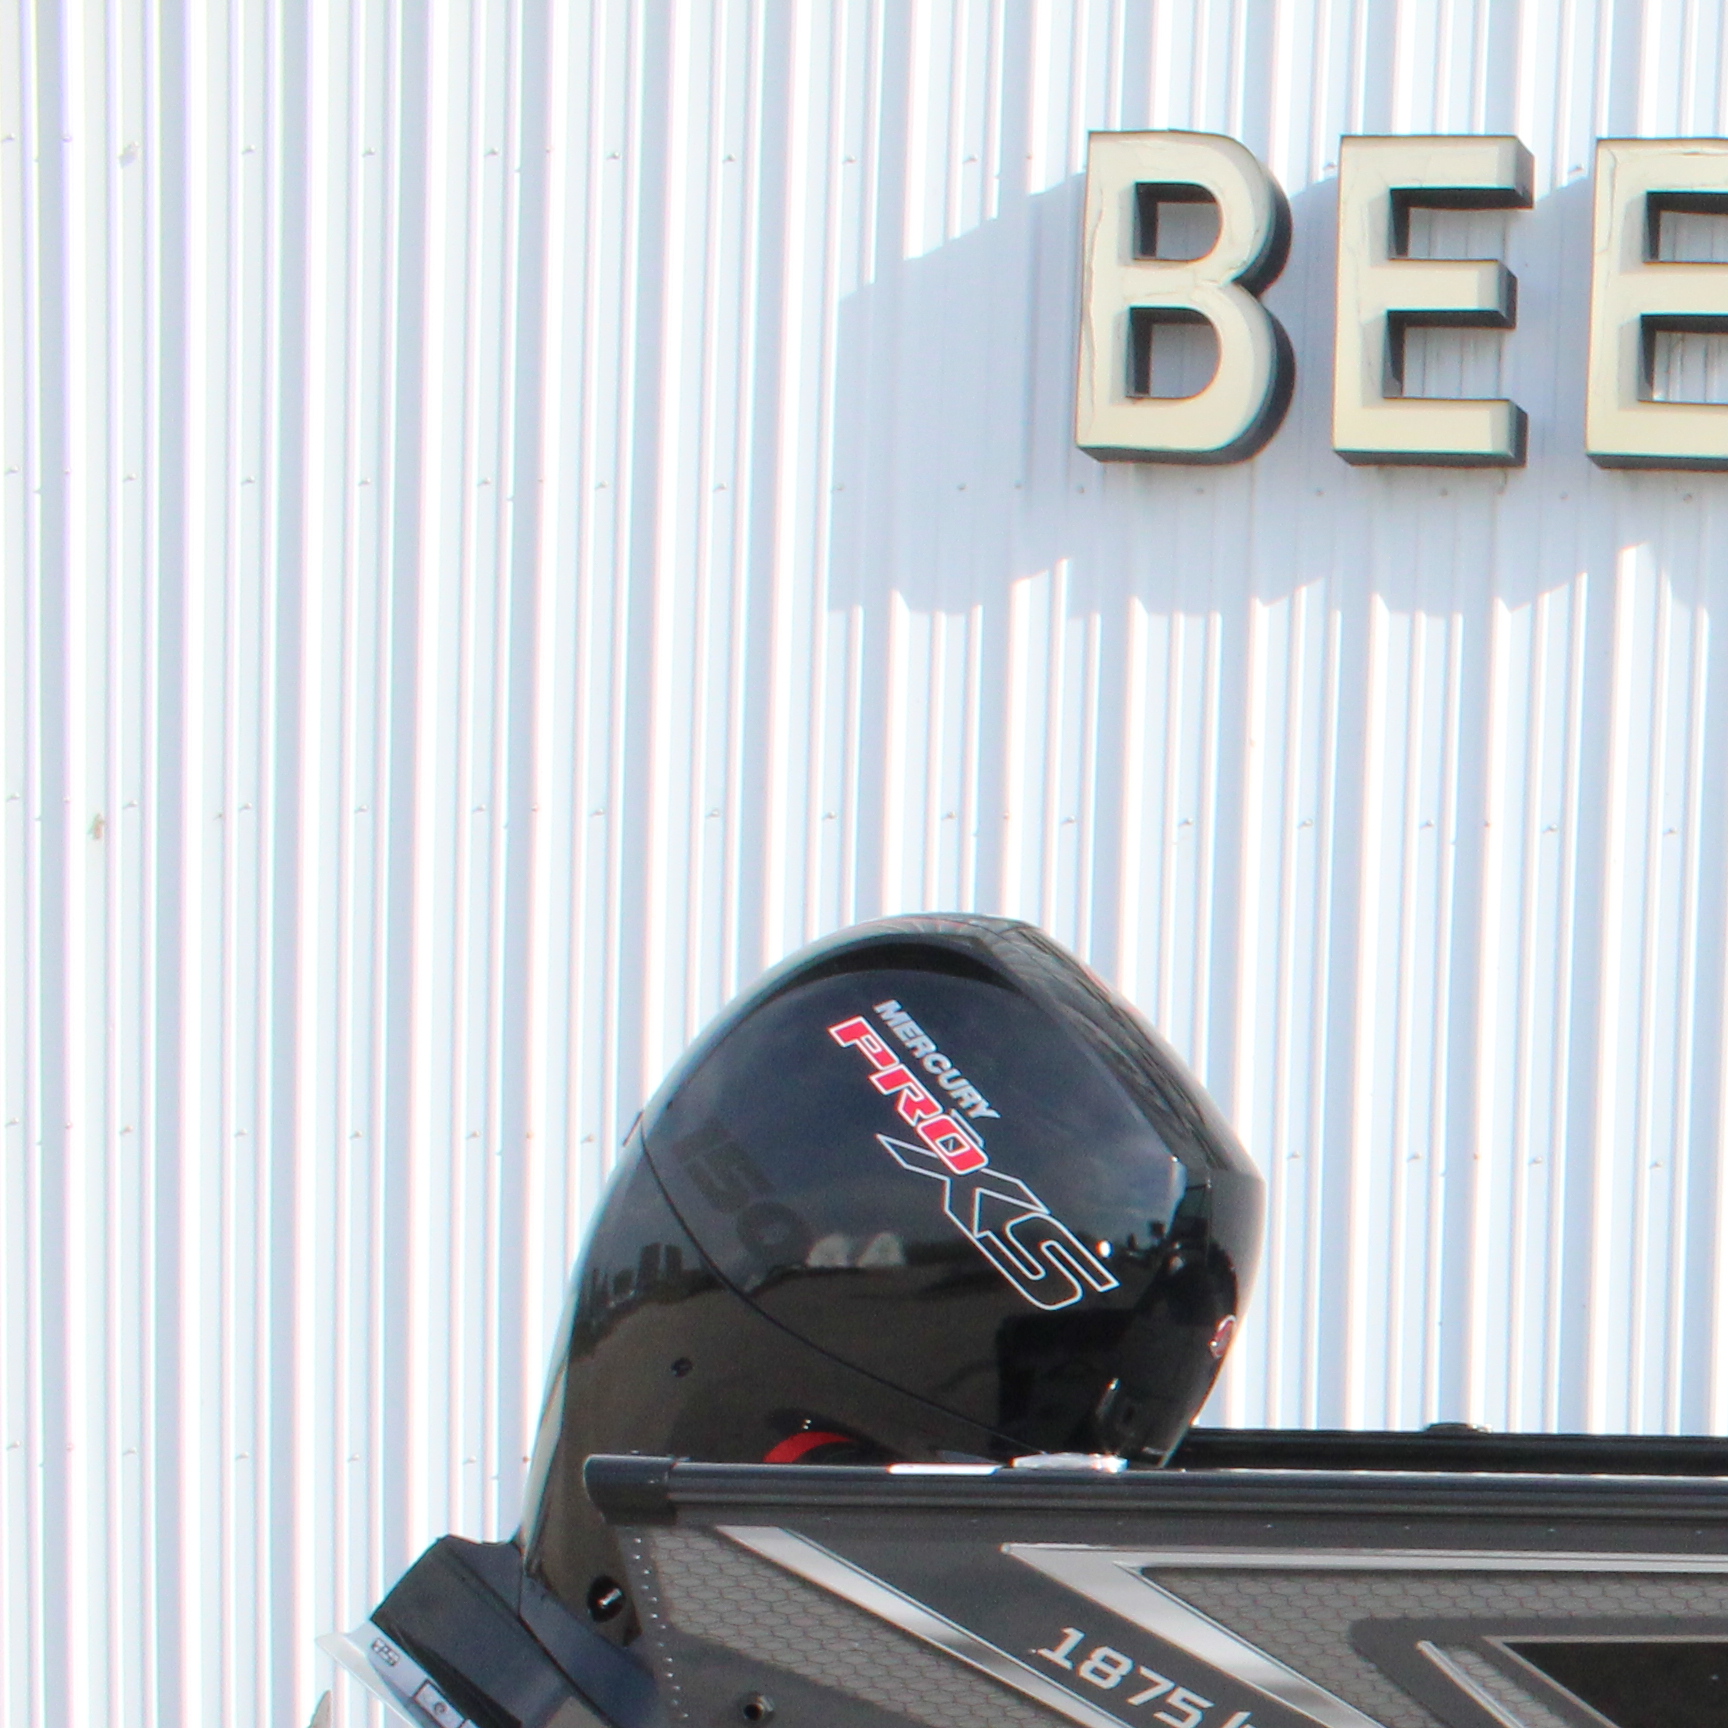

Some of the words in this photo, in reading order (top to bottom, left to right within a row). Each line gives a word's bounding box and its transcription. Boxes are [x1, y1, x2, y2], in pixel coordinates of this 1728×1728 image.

[828, 1015, 989, 1175] PRO
[872, 1000, 1000, 1119] MERCURY
[874, 1108, 1120, 1310] XS
